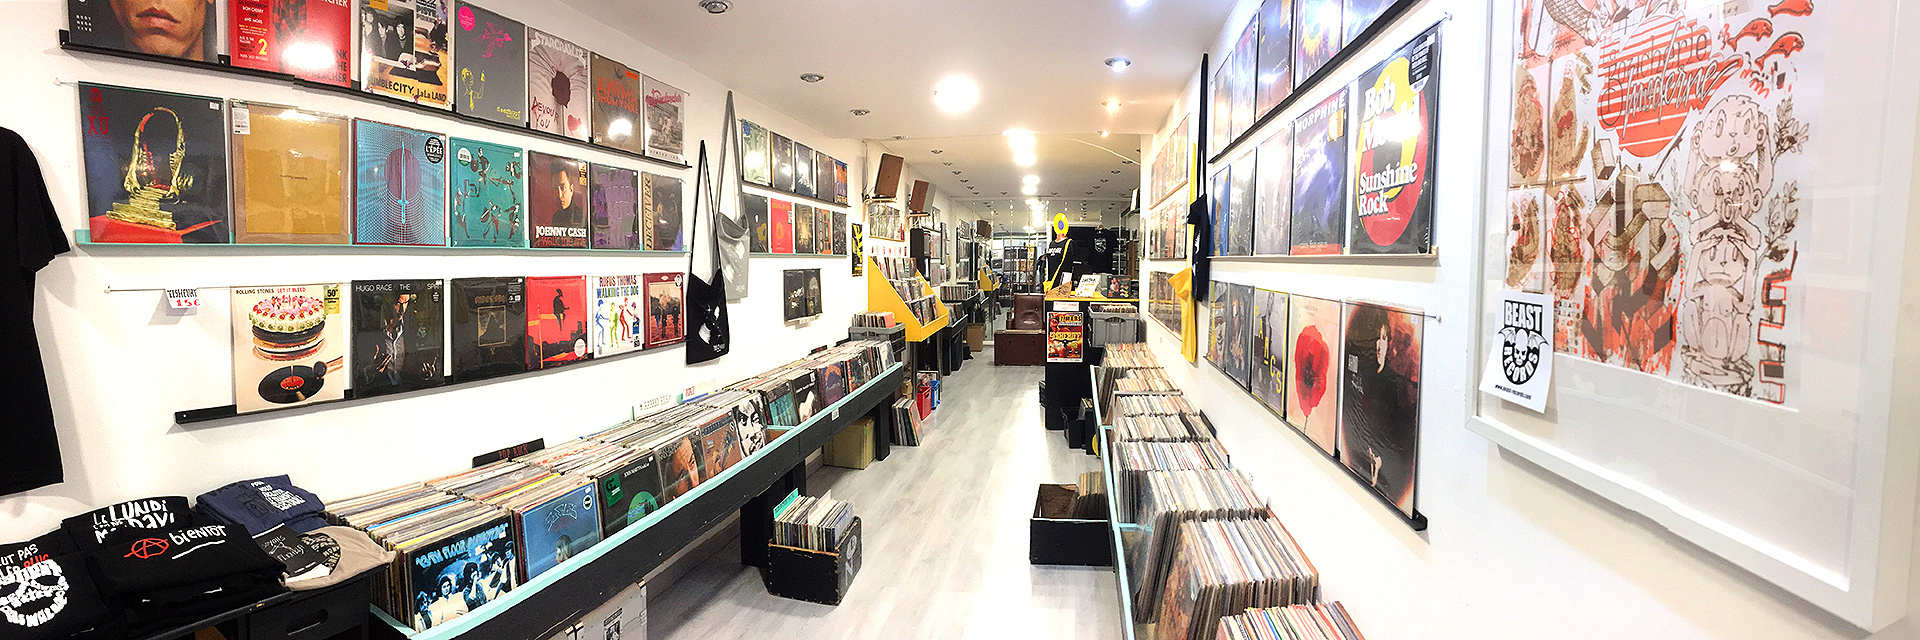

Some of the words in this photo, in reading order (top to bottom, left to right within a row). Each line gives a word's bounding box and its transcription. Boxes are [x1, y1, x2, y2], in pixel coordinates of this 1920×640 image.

[258, 38, 268, 55] 2
[531, 31, 587, 68] STARCRAWLER
[431, 92, 447, 102] LAND
[1364, 75, 1396, 121] Bob
[1296, 90, 1345, 133] MORPHINE
[536, 115, 551, 129] YOU
[1360, 161, 1418, 194] Sunshine
[642, 177, 653, 249] DECEIVER
[1359, 191, 1389, 216] Rock
[535, 225, 567, 238] JOHNNY
[568, 227, 587, 238] CASH
[355, 284, 375, 292] HUGO
[400, 283, 411, 291] THE
[600, 275, 616, 287] RUFUS
[617, 275, 637, 287] THOMAS
[596, 287, 620, 299] WALKING
[620, 287, 630, 297] THE
[630, 286, 639, 296] DOG
[1505, 302, 1542, 331] BEAST
[1503, 345, 1538, 382] RECORDS
[17, 543, 39, 561] PAS
[442, 540, 468, 560] FLOOR
